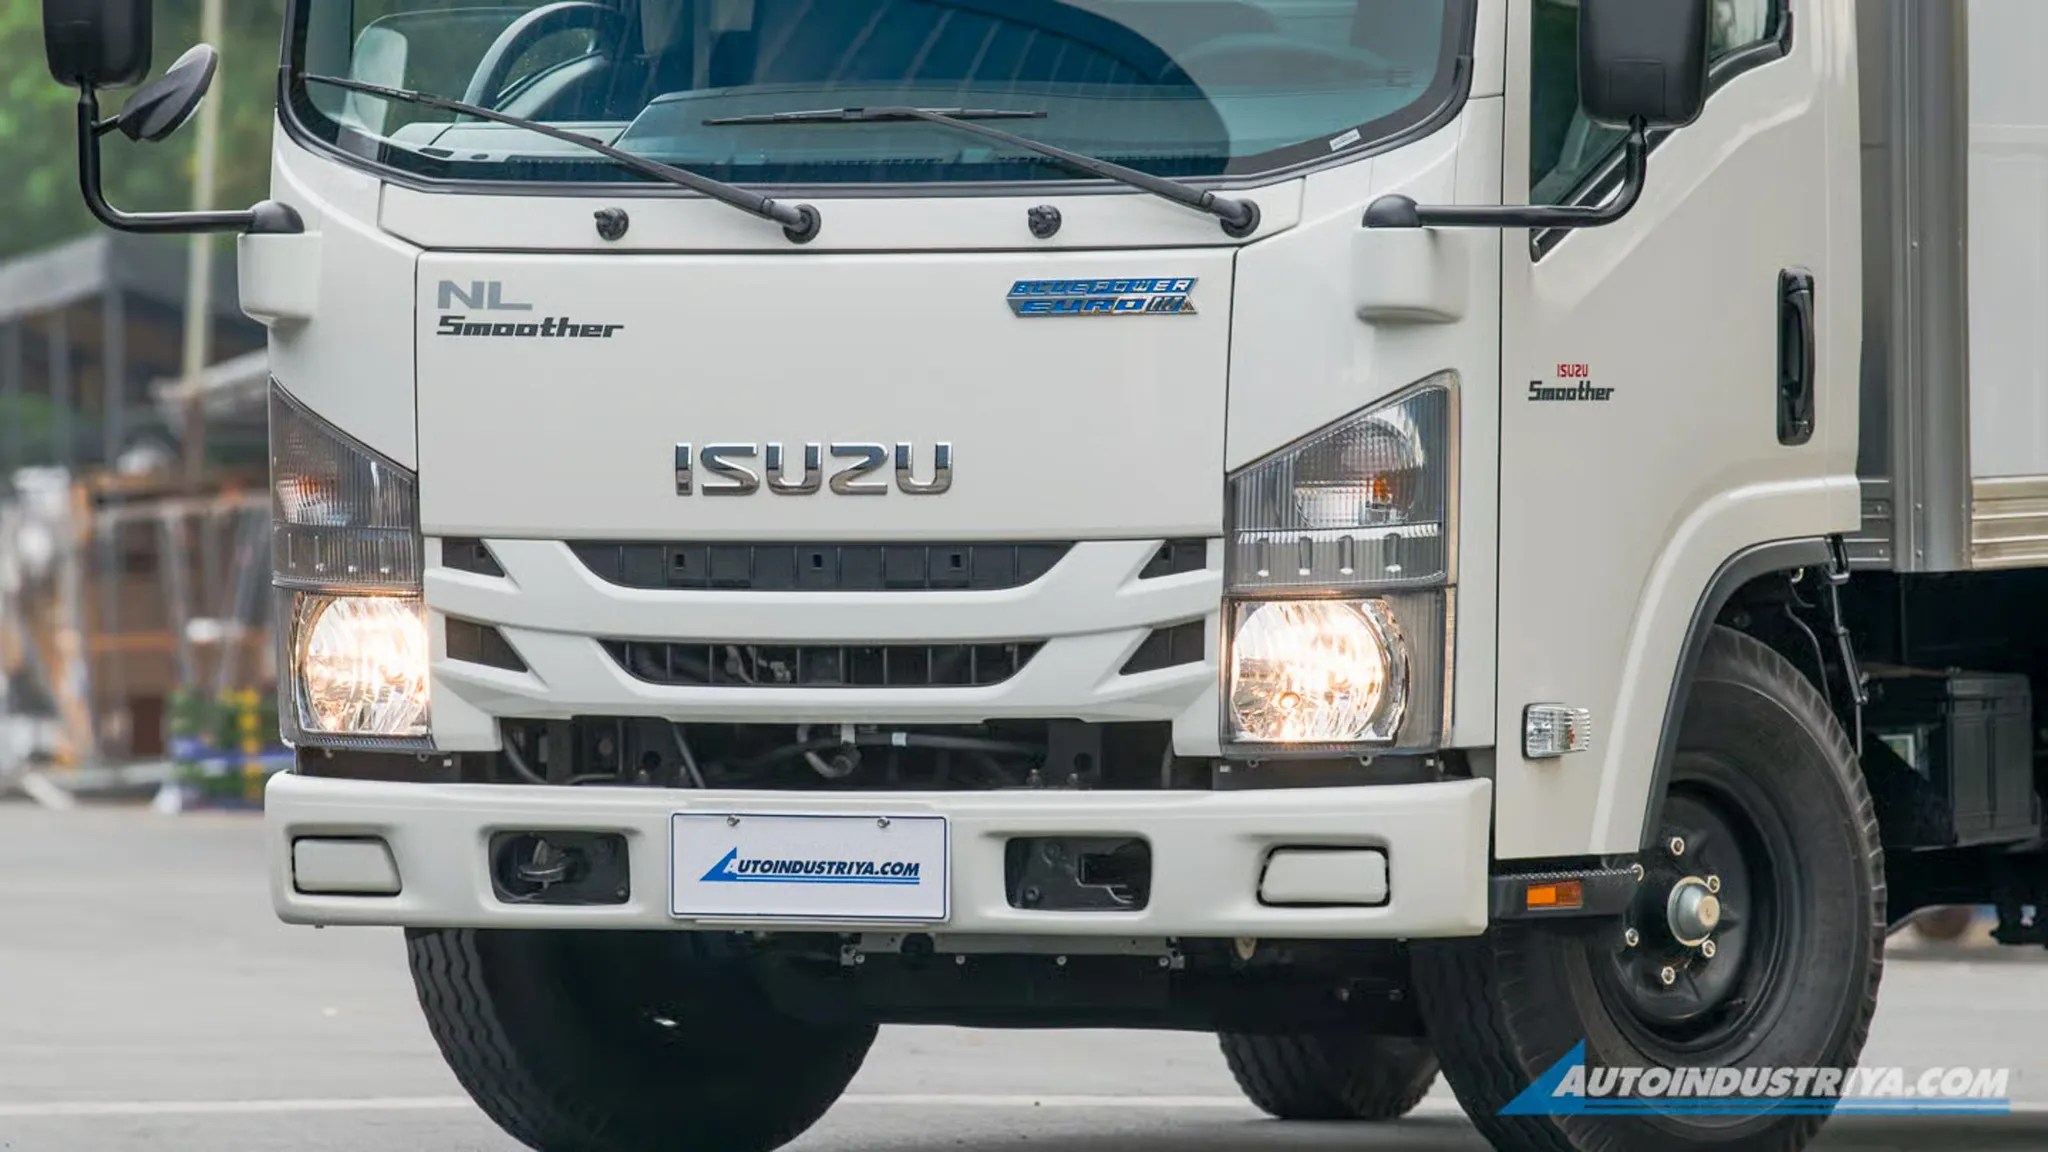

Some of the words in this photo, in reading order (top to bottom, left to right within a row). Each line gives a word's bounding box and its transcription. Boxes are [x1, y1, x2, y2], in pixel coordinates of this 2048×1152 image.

[437, 280, 533, 310] NL
[1019, 297, 1147, 314] EURO
[436, 315, 624, 338] Smoother
[1557, 364, 1588, 378] ISUZU
[1528, 380, 1615, 401] Smoother
[675, 442, 953, 496] ISUZU
[722, 857, 920, 877] AUTOINDUSTRIYA.COM
